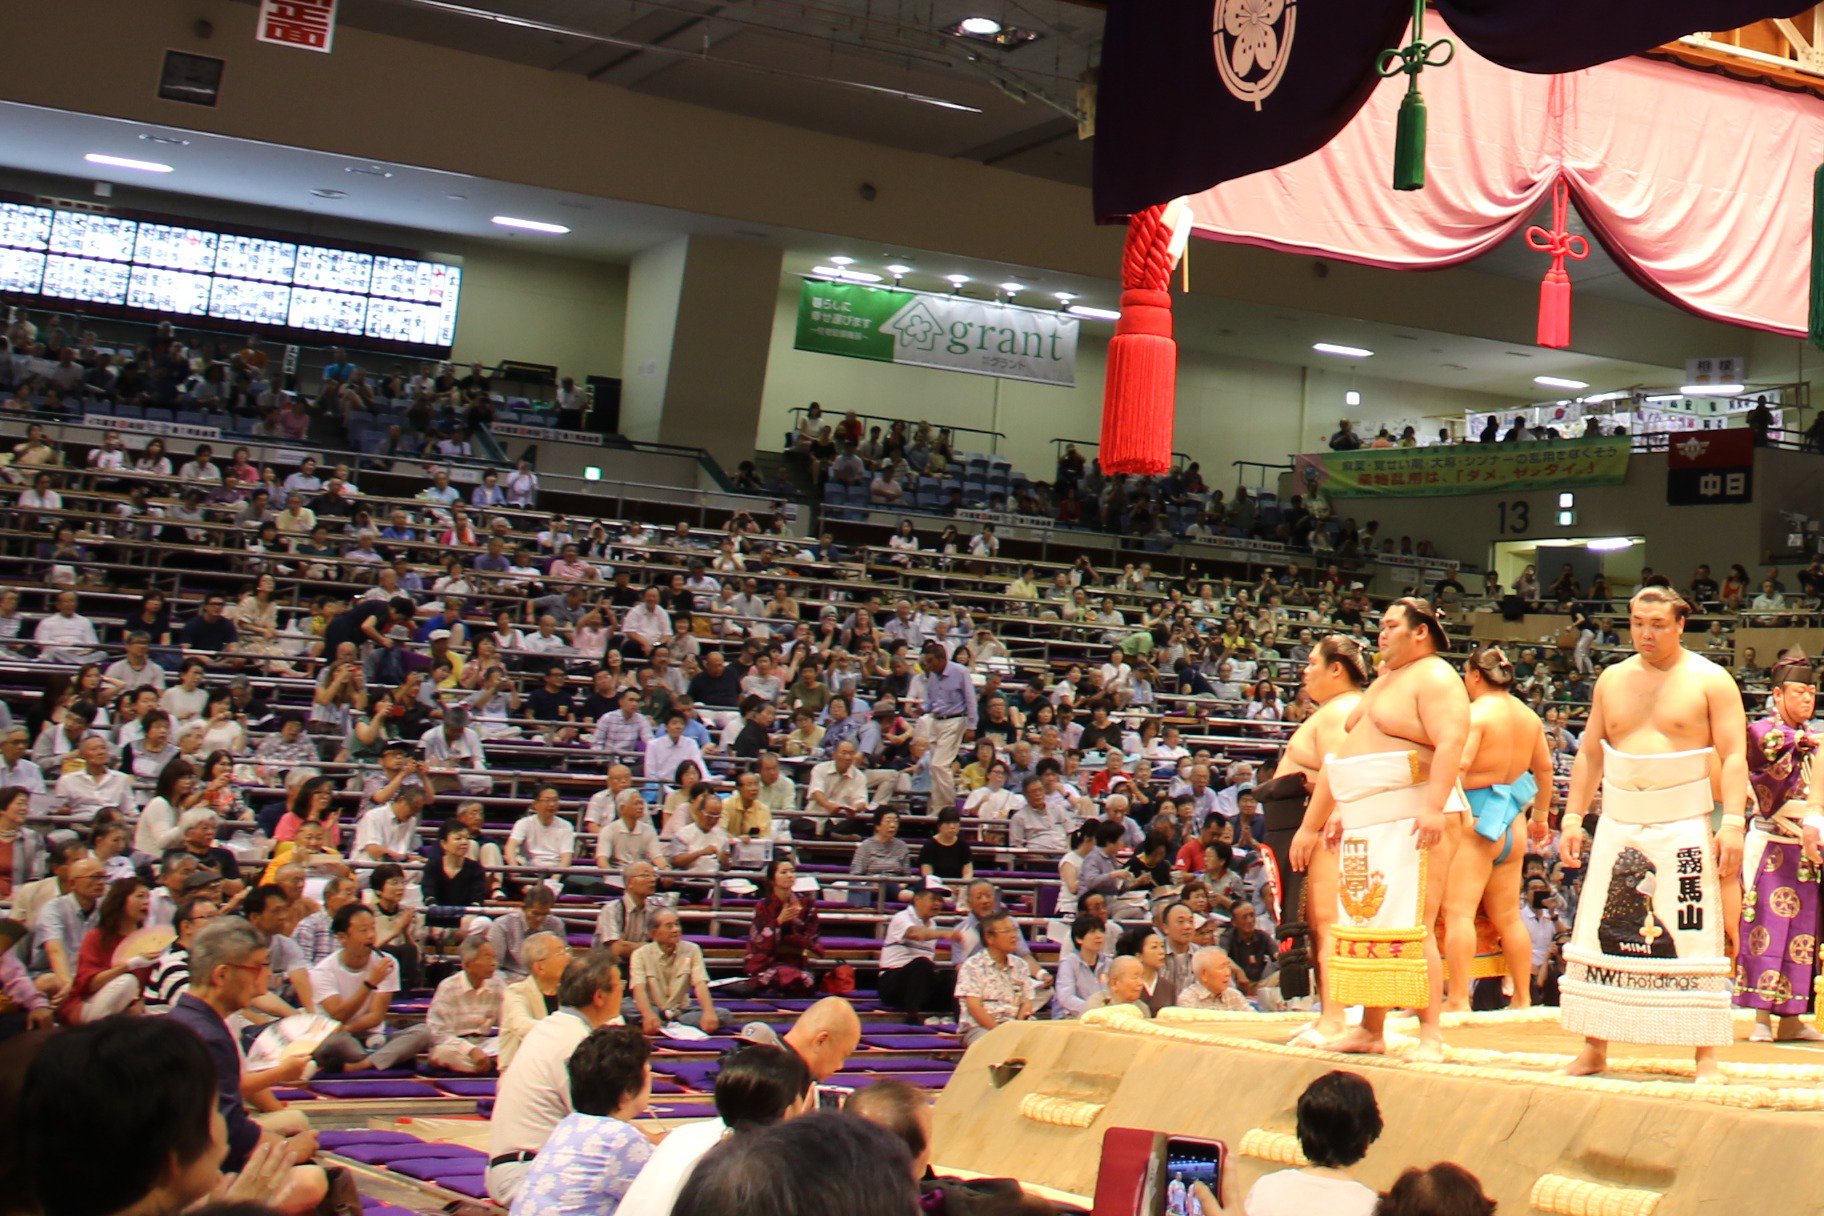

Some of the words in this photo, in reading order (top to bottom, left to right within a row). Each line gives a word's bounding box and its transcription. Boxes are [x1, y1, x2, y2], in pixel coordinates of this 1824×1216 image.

[946, 320, 1063, 362] grant
[1699, 472, 1745, 497] 中日
[1497, 500, 1530, 534] 13
[1676, 846, 1703, 931] 霧馬山
[1618, 941, 1653, 955] MIMI
